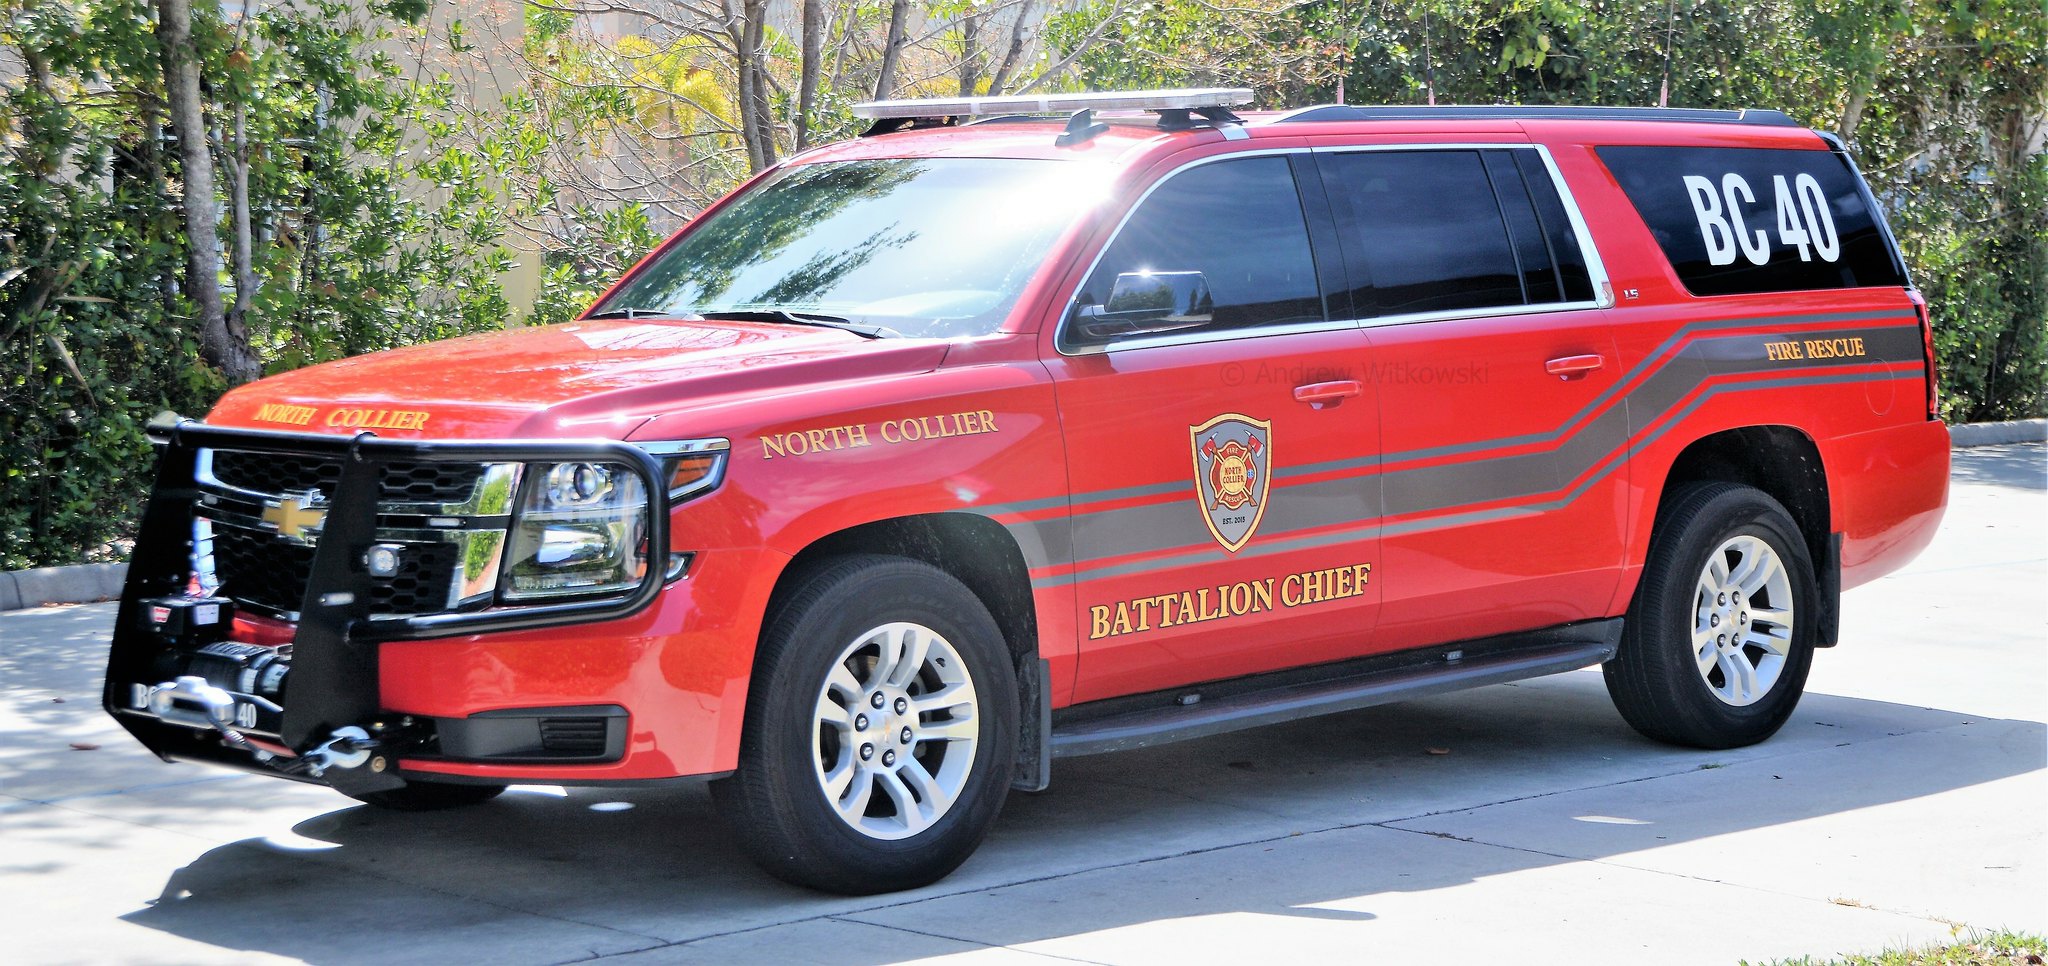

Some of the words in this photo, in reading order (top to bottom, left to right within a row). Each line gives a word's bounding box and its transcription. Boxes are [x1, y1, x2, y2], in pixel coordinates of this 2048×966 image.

[1682, 172, 1770, 266] BC
[1772, 173, 1840, 262] 40
[1764, 341, 1804, 361] FIRE
[1804, 337, 1866, 359] RESCUE
[252, 403, 318, 426] NORTH
[325, 408, 430, 431] COLLIER
[759, 423, 872, 459] NORTH
[880, 409, 999, 444] COLLIER
[1223, 474, 1245, 484] COLLIER
[1224, 466, 1242, 475] NORTH
[1088, 578, 1276, 640] BATTALION
[1280, 562, 1372, 608] CHIEF
[237, 703, 257, 729] 40
